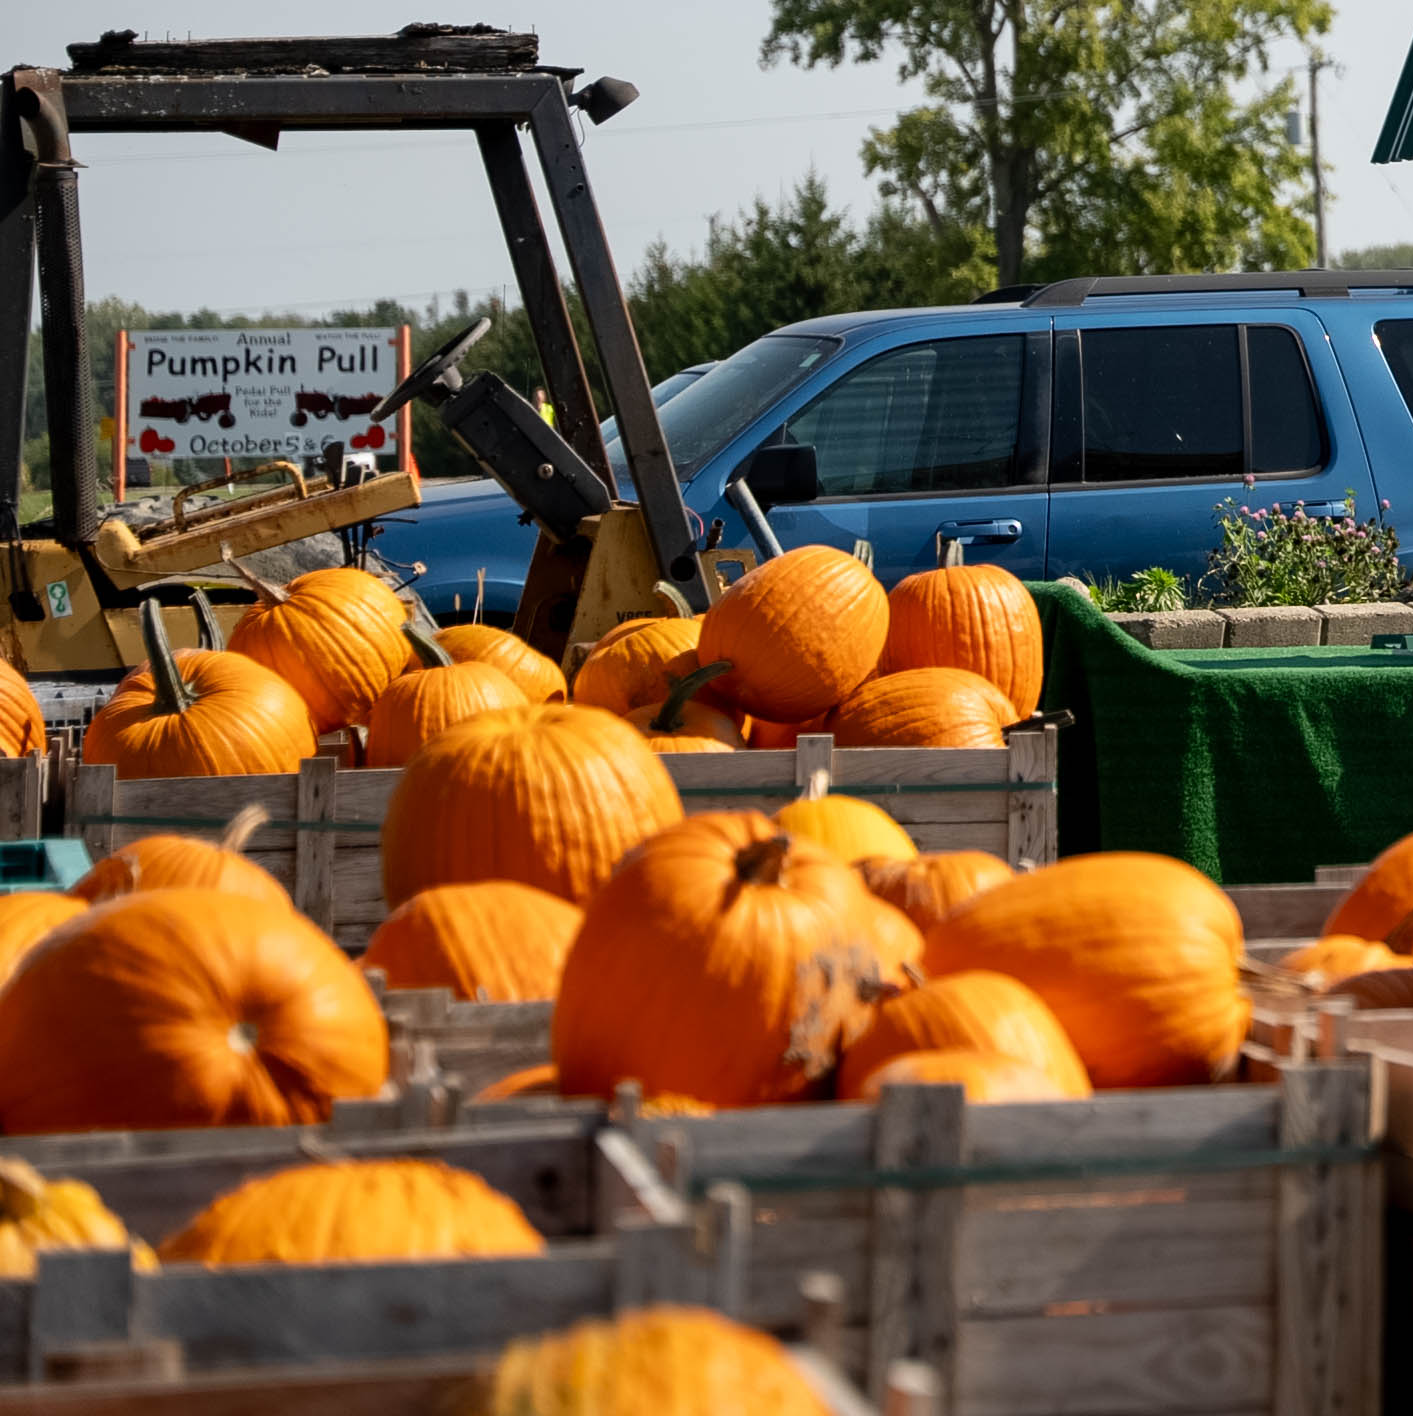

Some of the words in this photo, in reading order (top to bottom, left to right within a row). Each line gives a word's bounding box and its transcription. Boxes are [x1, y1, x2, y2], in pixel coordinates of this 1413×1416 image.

[236, 332, 292, 346] Annual
[146, 347, 297, 383] Pumpkin
[318, 344, 379, 374] Pull
[189, 434, 282, 455] October
